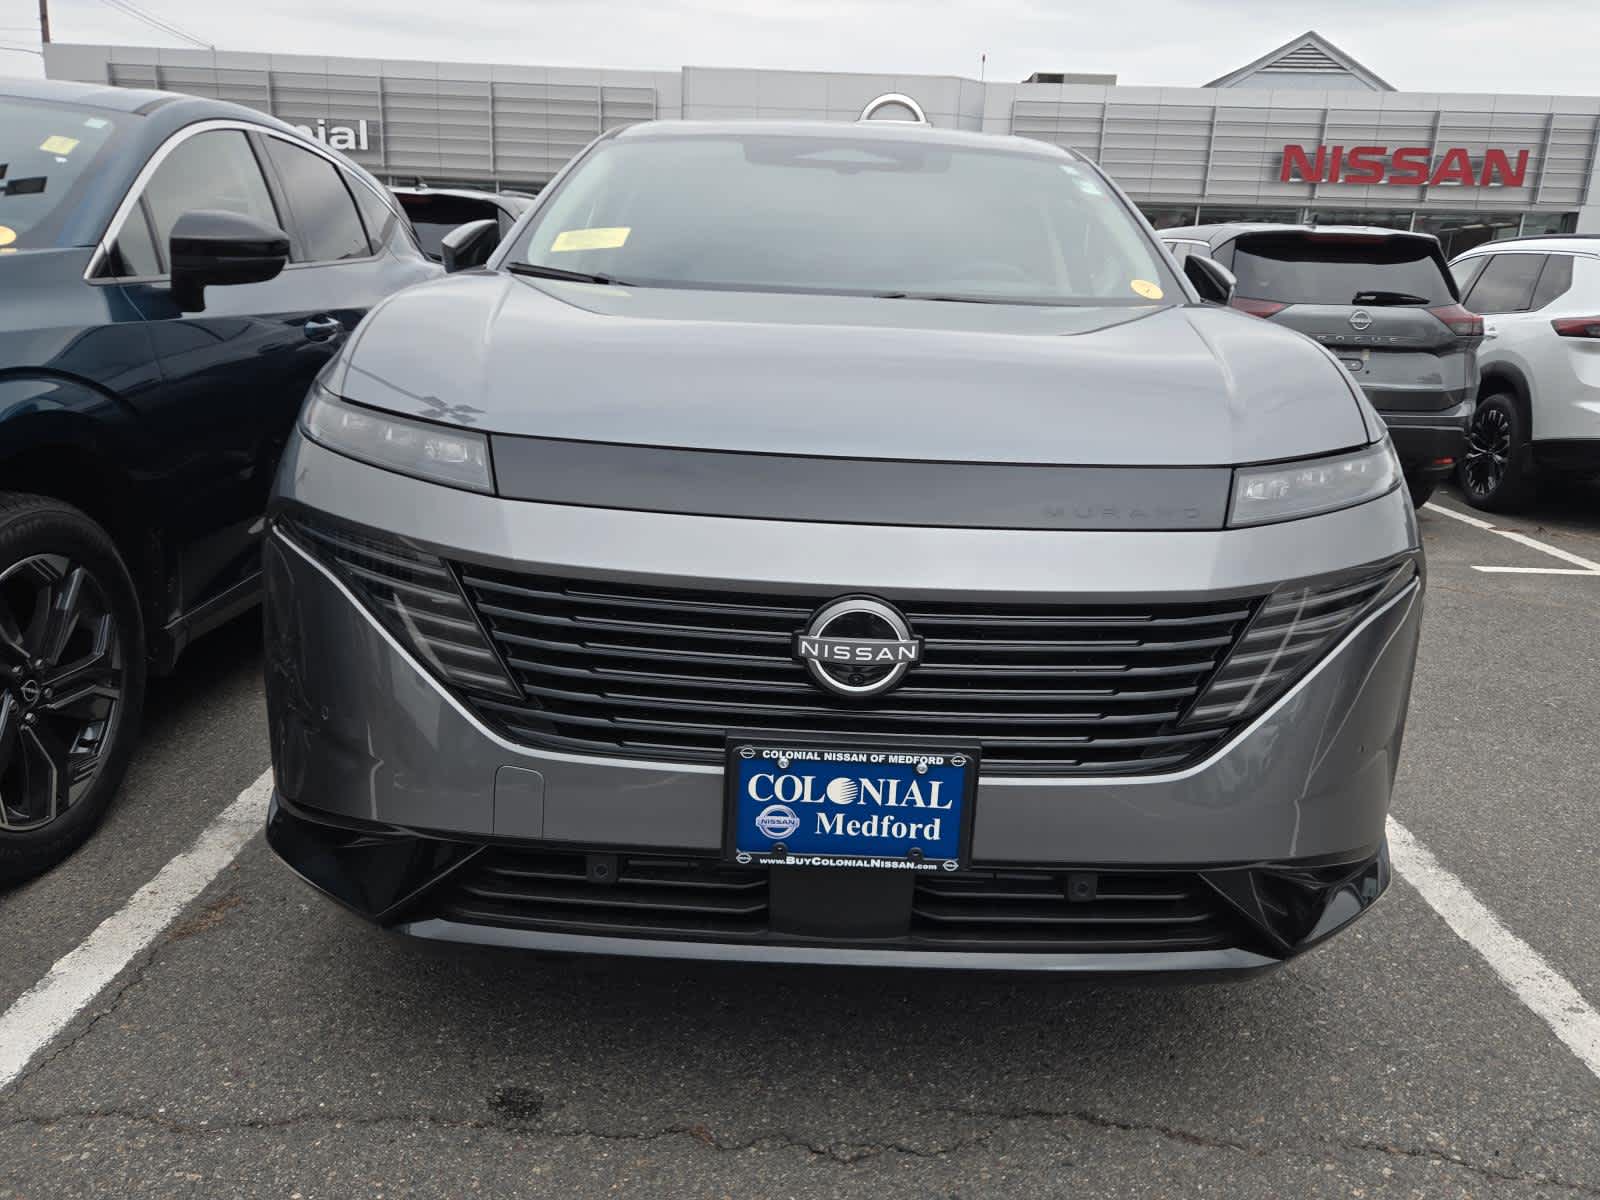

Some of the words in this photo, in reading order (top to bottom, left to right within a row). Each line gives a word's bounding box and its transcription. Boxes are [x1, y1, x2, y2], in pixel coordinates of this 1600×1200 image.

[1280, 144, 1530, 188] NISSAN
[801, 640, 916, 661] NISSAN
[762, 750, 820, 761] COLONIAL
[824, 752, 867, 763] NISSAN
[870, 754, 886, 763] OF
[888, 755, 944, 766] MEDFORD
[748, 773, 953, 809] COLONIAL
[815, 812, 941, 841] Medford
